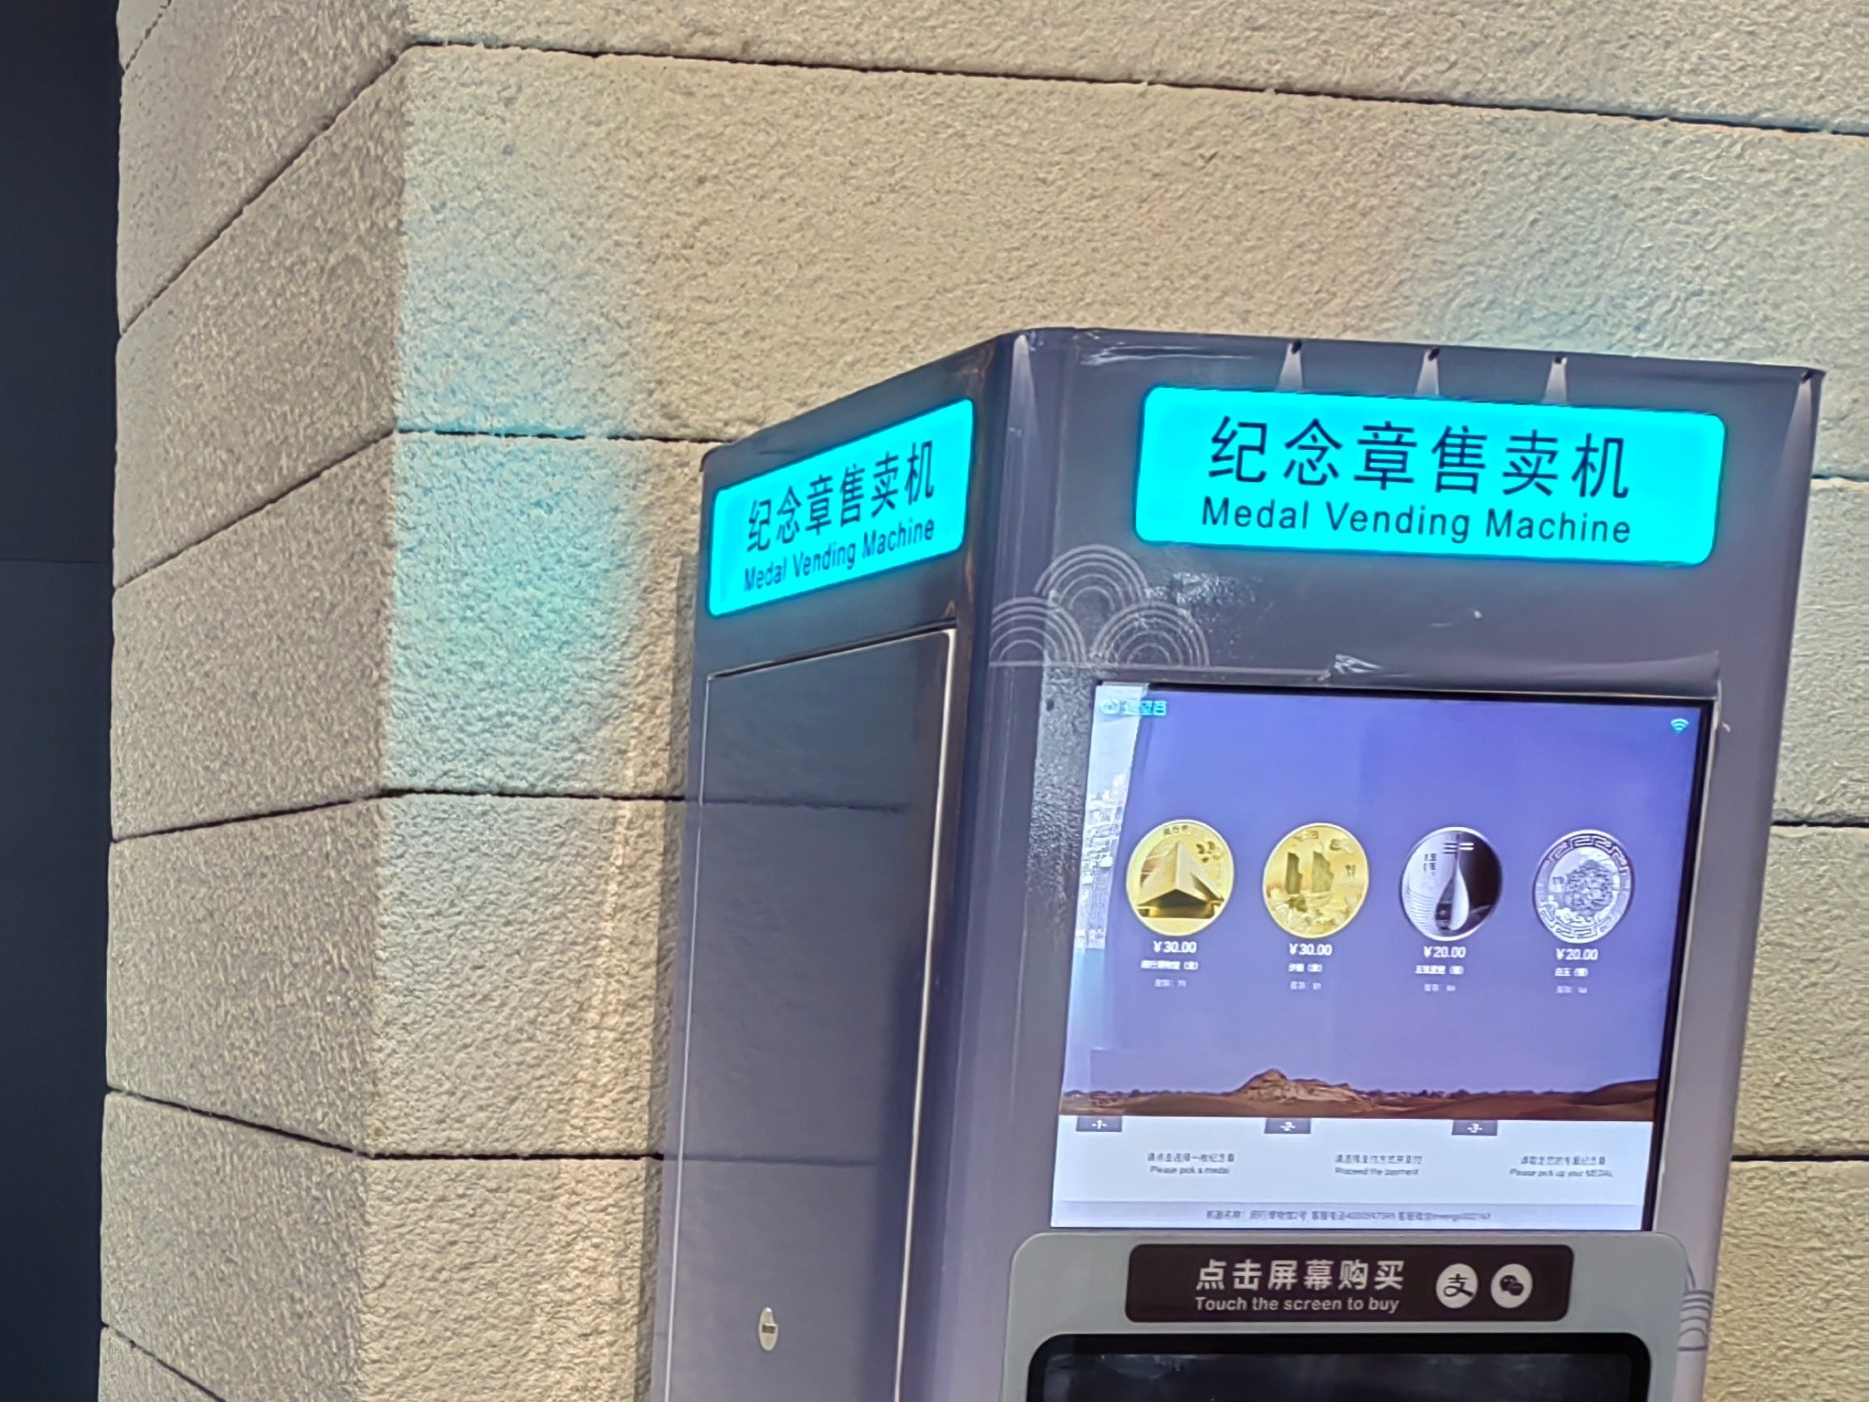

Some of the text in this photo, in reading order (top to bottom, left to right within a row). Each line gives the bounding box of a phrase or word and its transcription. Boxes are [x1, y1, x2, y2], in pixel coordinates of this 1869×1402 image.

[1208, 415, 1629, 499] 纪念章售卖机
[746, 440, 935, 553] 纪念章售卖机
[1201, 496, 1631, 543] Medal Vending Machine
[743, 517, 935, 592] Medal Vending Machine
[1195, 1297, 1400, 1314] Touch the screen to buy
[1196, 1259, 1405, 1291] 点击屏幕购买
